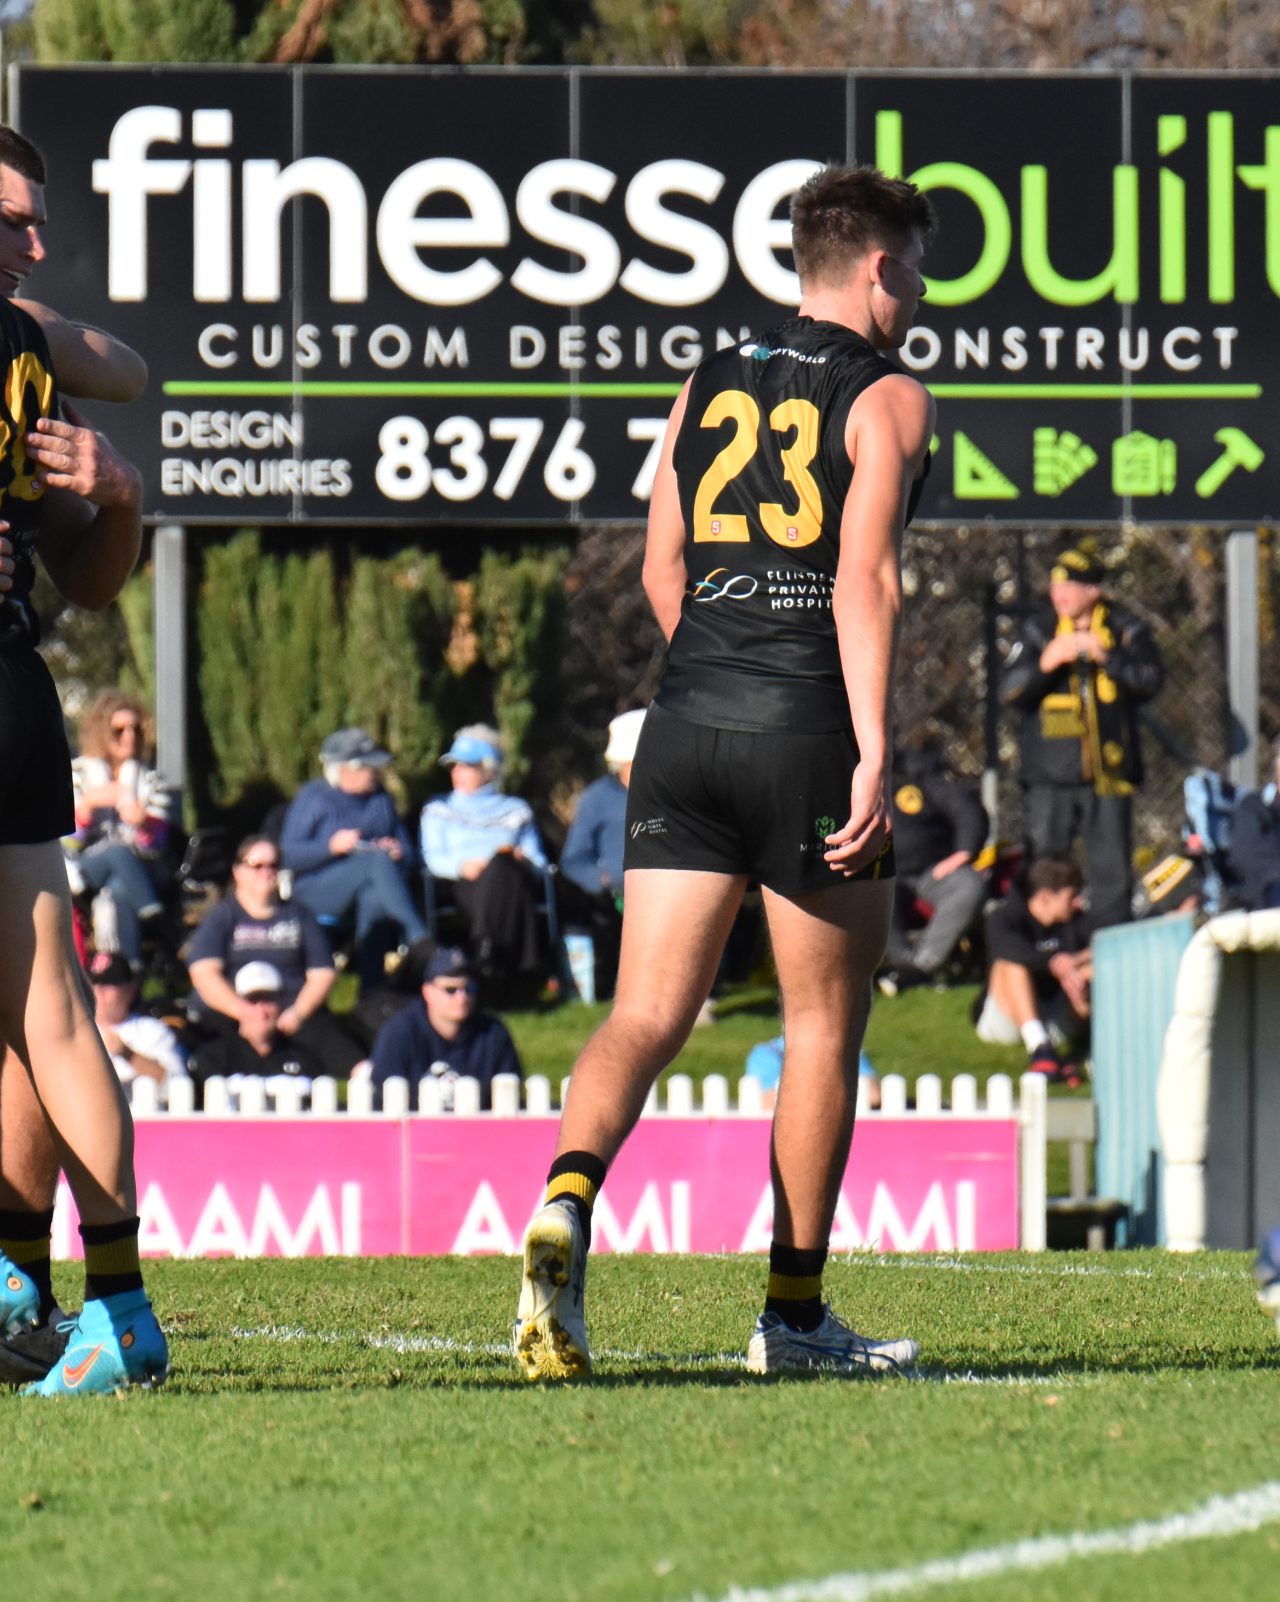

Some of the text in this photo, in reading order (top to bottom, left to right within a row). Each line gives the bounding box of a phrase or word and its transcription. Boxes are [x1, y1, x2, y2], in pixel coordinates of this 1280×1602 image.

[197, 323, 470, 369] CUSTOM
[898, 326, 1240, 371] ONSTRUCT
[160, 410, 303, 449] DESIGN
[160, 458, 353, 497] ENQUIRIES
[374, 415, 596, 501] 8376
[693, 390, 823, 548] 23
